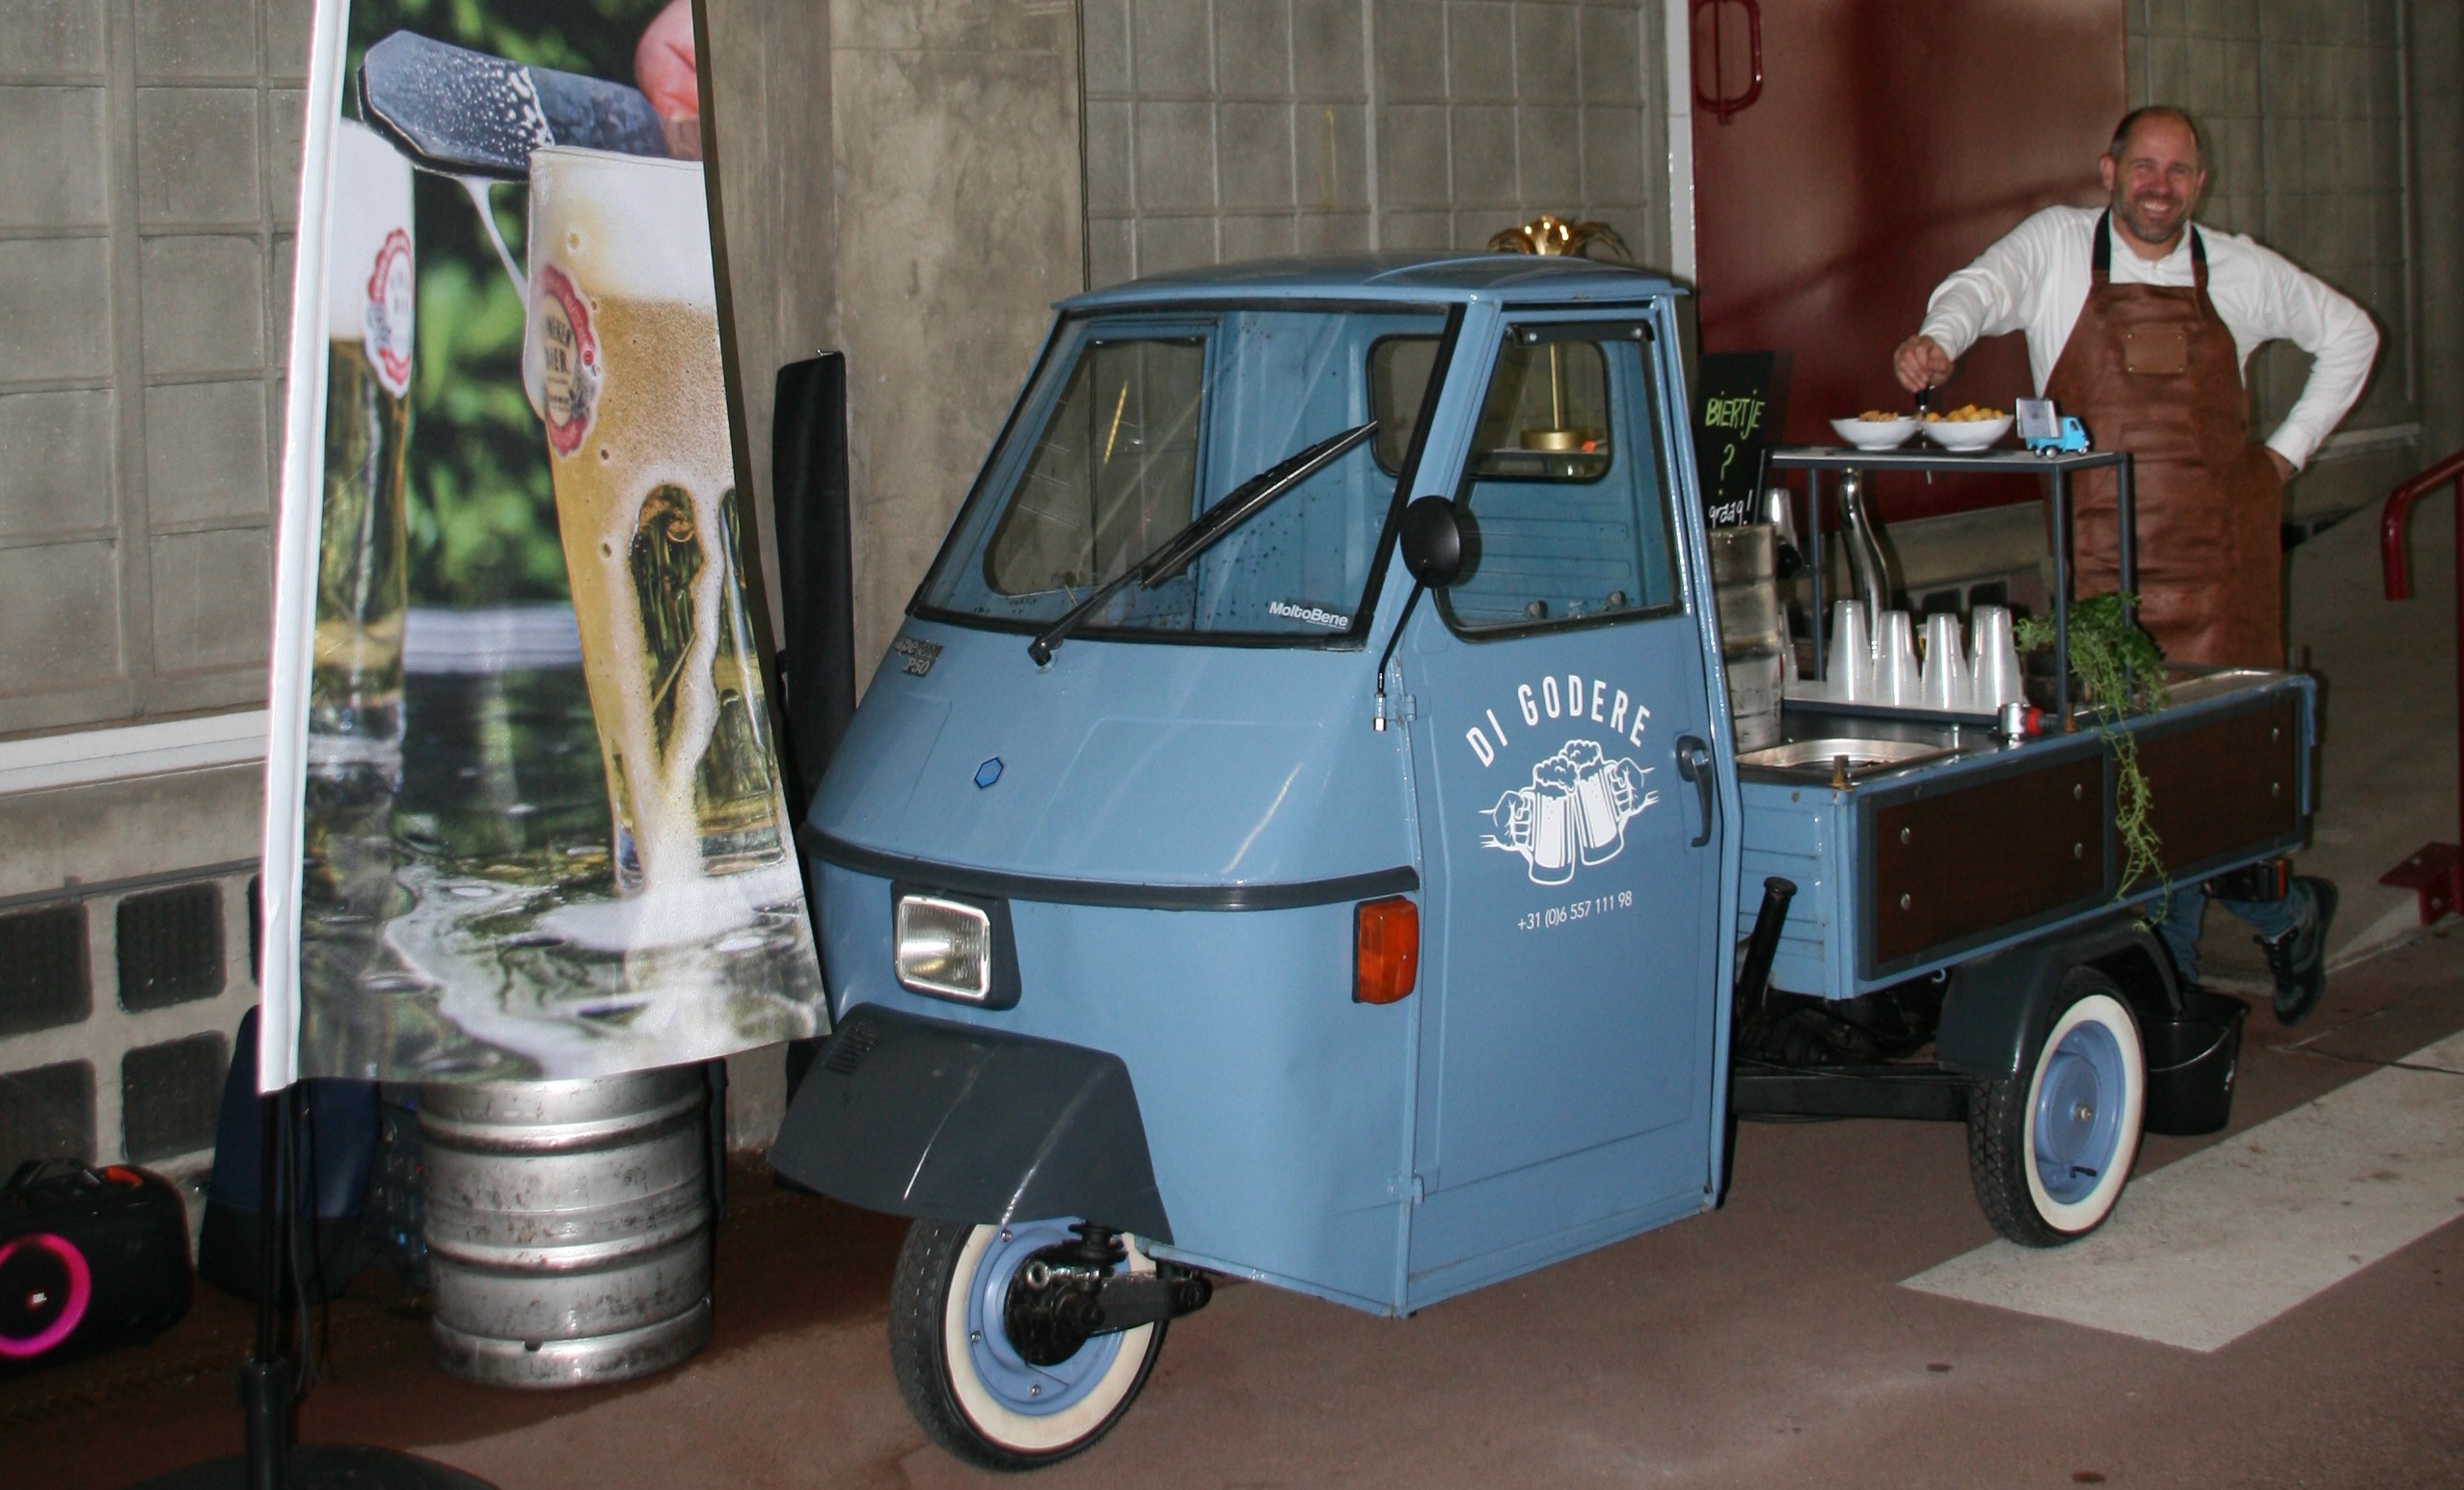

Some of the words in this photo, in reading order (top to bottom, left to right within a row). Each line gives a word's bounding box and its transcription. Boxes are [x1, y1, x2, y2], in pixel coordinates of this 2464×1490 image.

[1269, 602, 1348, 626] MoltoBene
[902, 657, 931, 674] P50
[1466, 709, 1508, 768] DI
[1517, 675, 1651, 747] GODERE
[1518, 911, 1541, 930] +31
[1545, 907, 1567, 928] (0)6
[1570, 900, 1591, 919] 557
[1595, 895, 1614, 913] 111
[1618, 891, 1633, 908] 98
